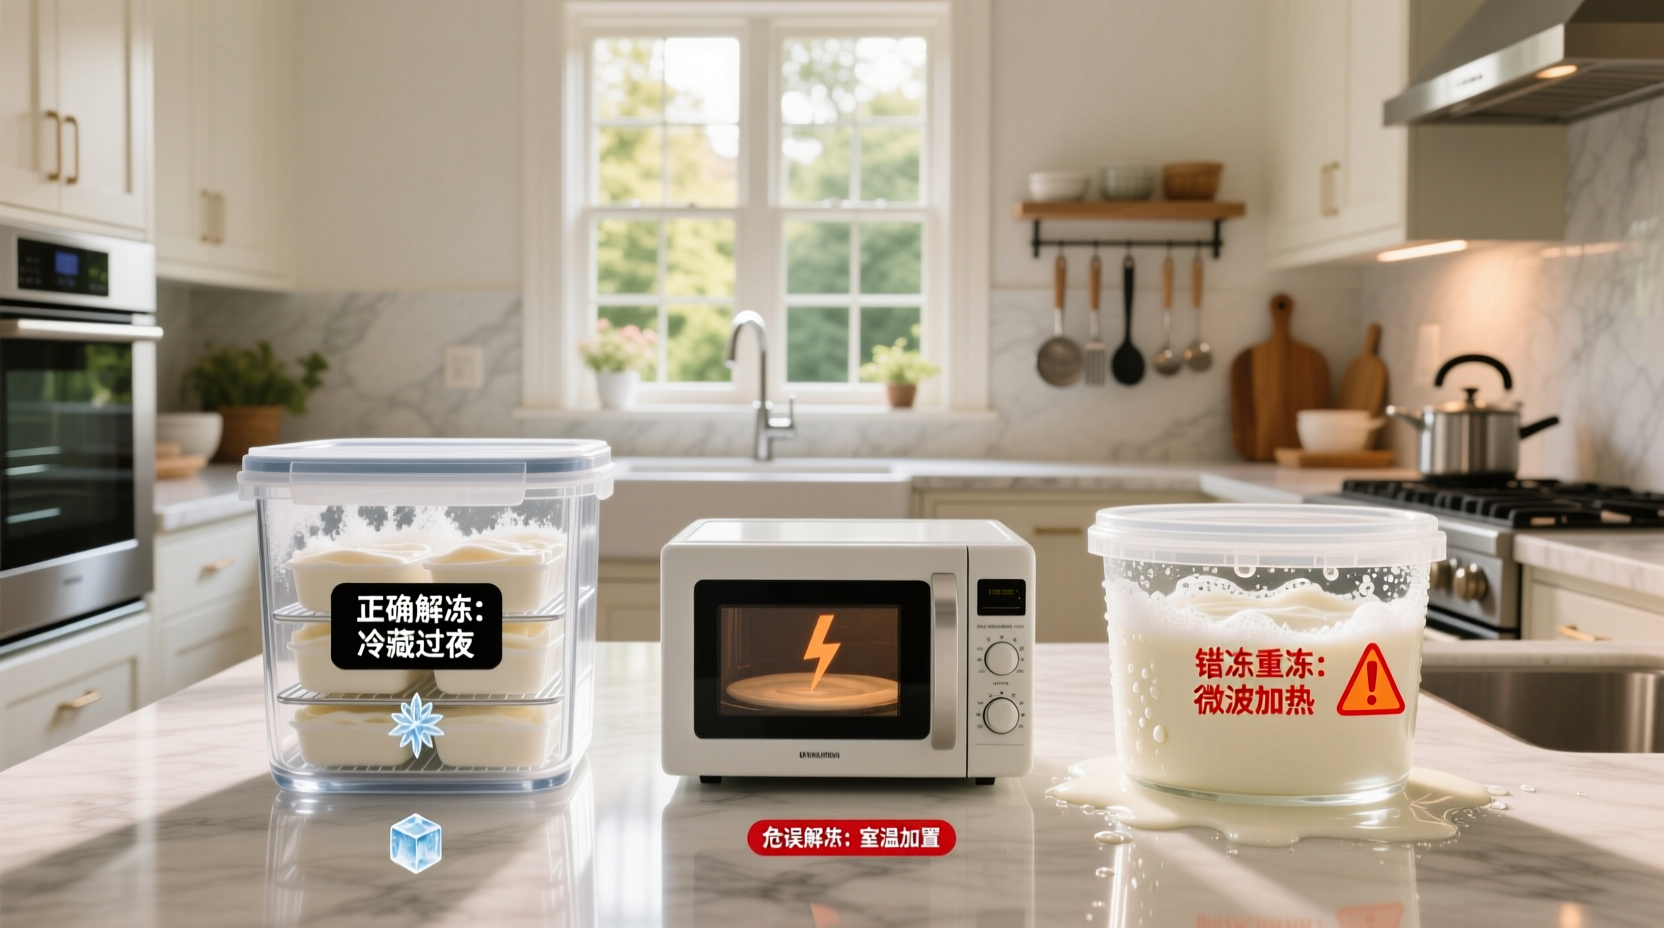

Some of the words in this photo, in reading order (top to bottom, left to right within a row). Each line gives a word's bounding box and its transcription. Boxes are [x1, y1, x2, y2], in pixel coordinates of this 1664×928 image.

[1195, 646, 1326, 679] 错冻重冻：
[1193, 684, 1315, 715] 微波加热
